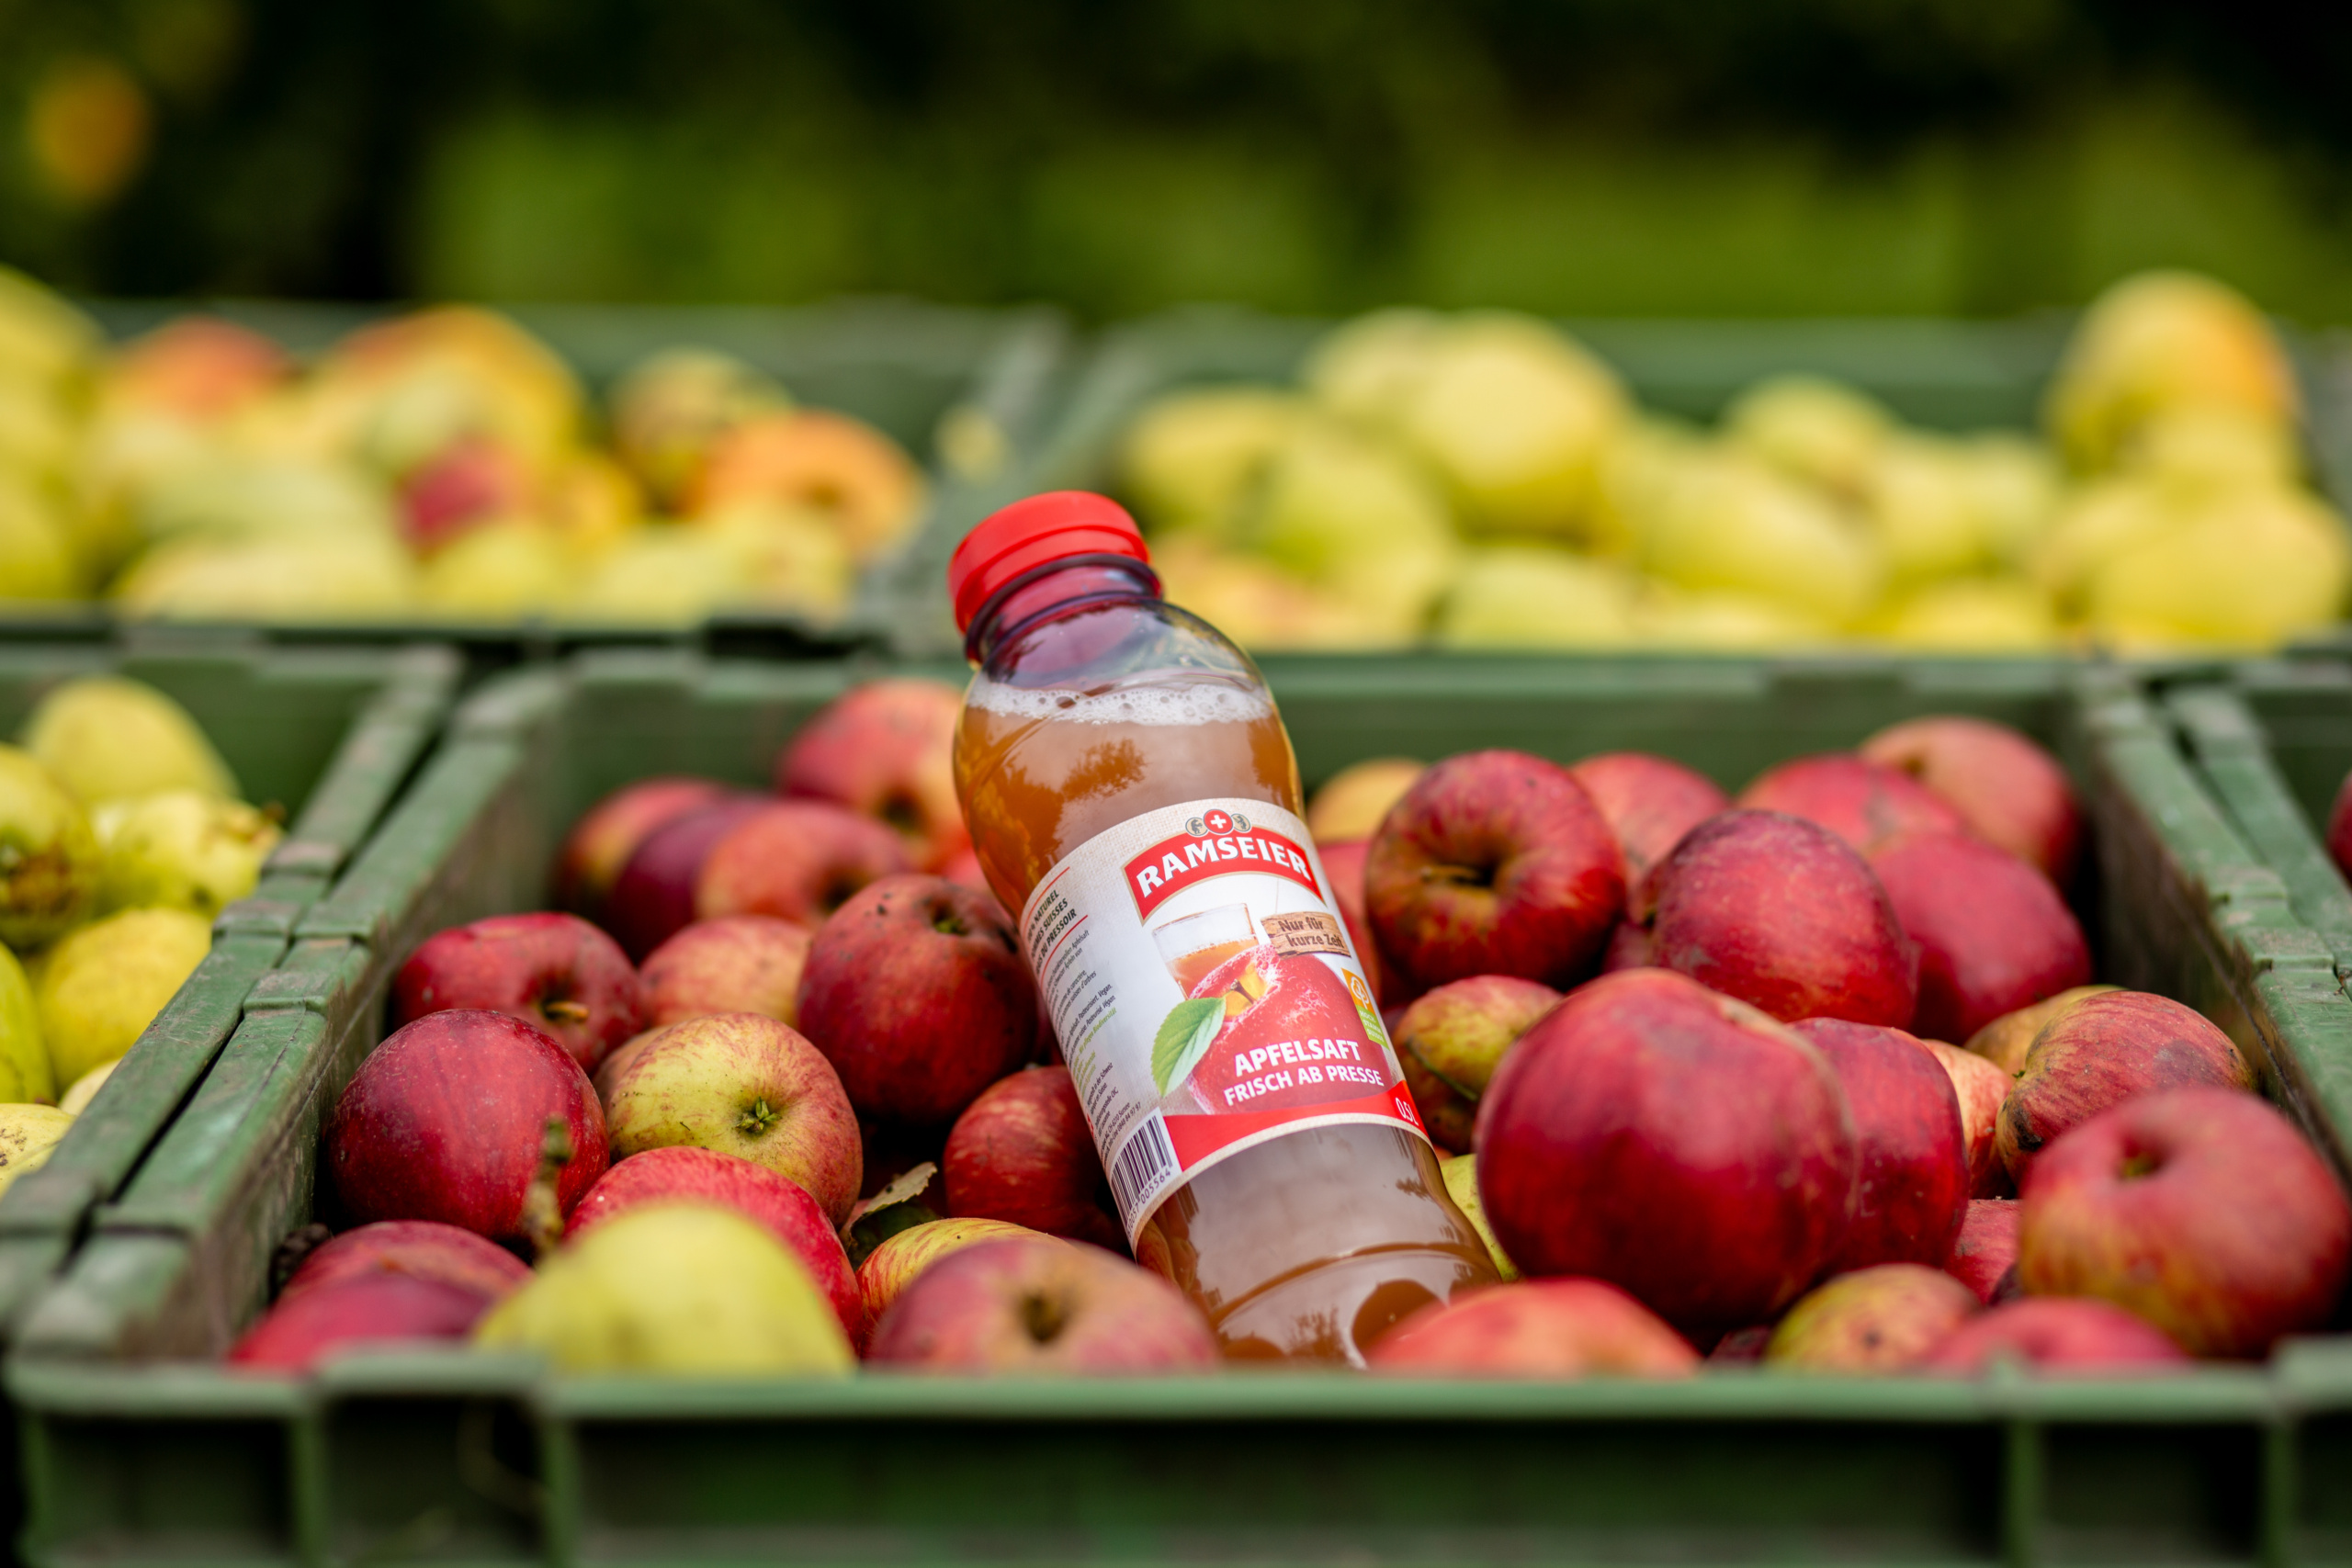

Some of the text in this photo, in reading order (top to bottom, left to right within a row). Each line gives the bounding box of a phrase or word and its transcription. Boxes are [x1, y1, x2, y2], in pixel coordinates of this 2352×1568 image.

[1136, 837, 1313, 898] RAMSEIER
[1034, 889, 1059, 924] NATUREL
[1043, 897, 1069, 931] SUISSES
[1277, 916, 1324, 932] Nur für
[1046, 908, 1078, 947] PRESSOIR
[1285, 933, 1345, 948] kurze Zeit
[1235, 1038, 1362, 1077] APFELSAFT
[1223, 1065, 1385, 1106] FRISCH AB PRESSE
[1140, 1168, 1170, 1204] 005564
